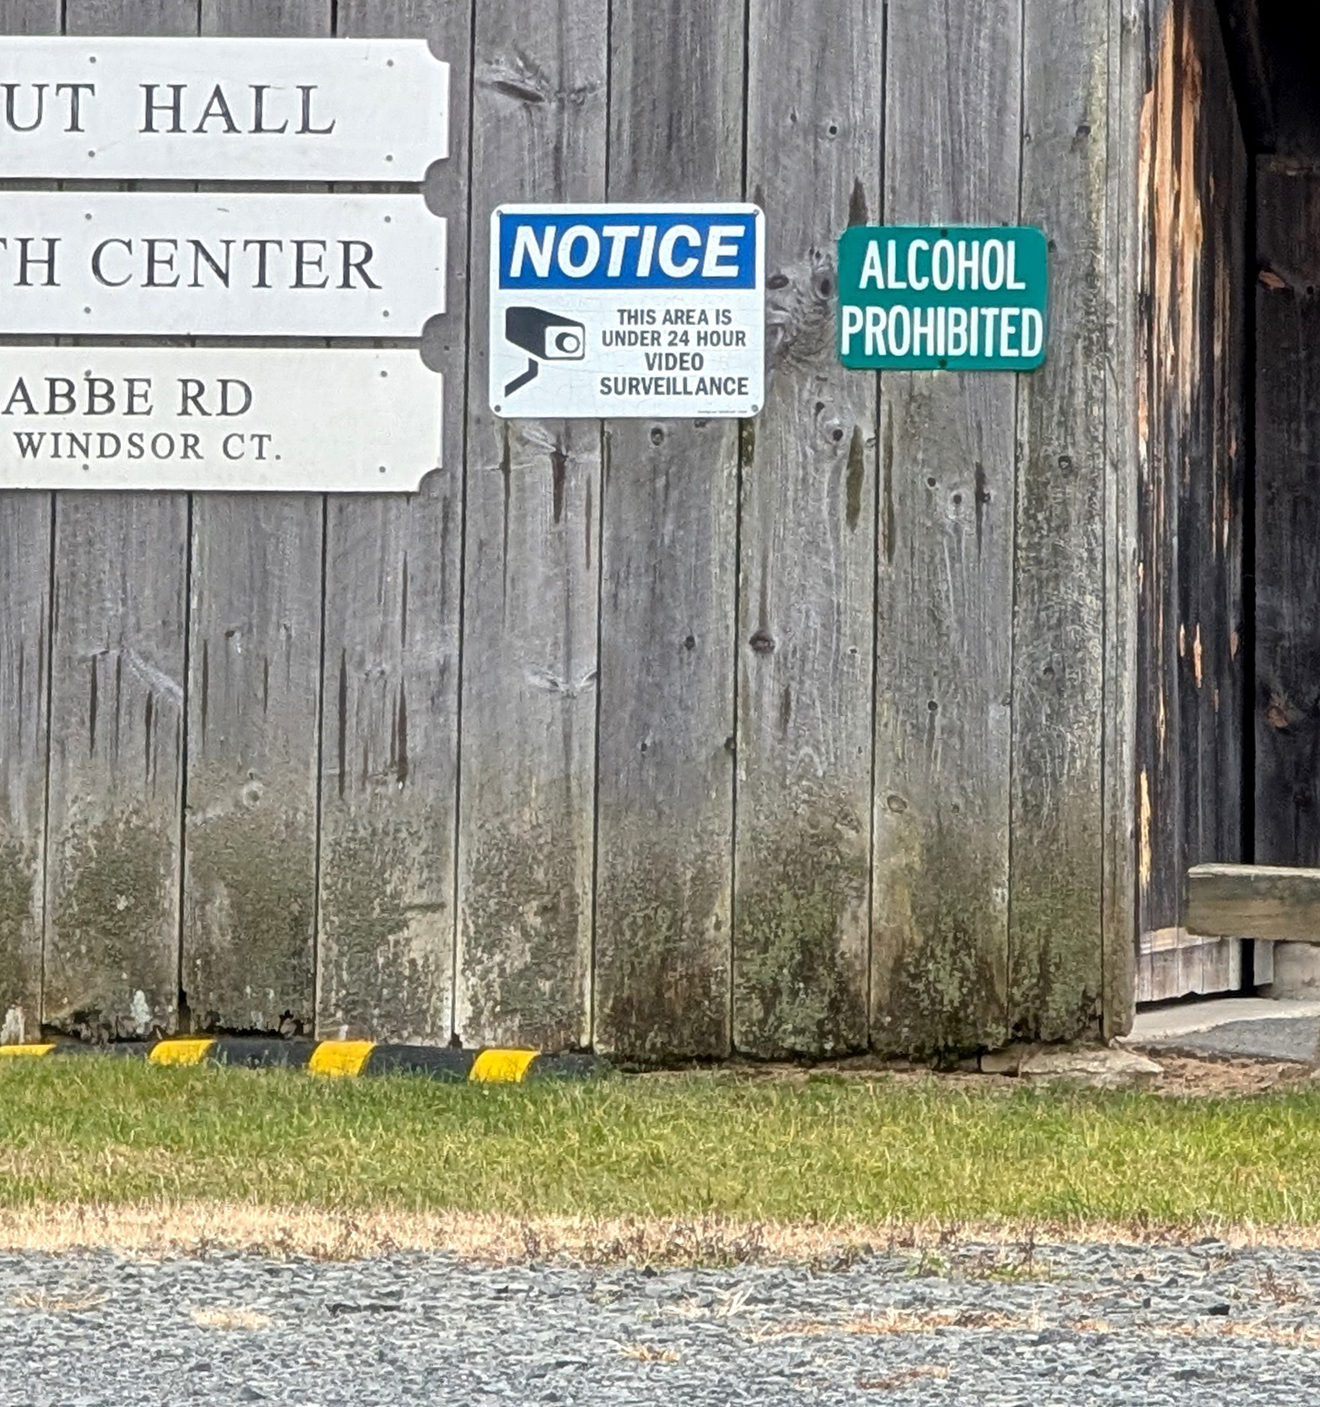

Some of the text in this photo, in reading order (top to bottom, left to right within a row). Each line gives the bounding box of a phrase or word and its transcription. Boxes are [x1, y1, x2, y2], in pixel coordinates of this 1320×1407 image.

[138, 84, 337, 135] HALL
[90, 238, 382, 290] CENTER
[509, 223, 746, 279] NOTICE
[859, 239, 1027, 291] ALCOHOL
[616, 308, 733, 326] THIS AREA IS
[840, 304, 1044, 358] PROHIBITED
[601, 330, 747, 348] UNDER 24 HOUR
[644, 352, 705, 371] VIDEO
[1, 376, 154, 417] ABBE
[176, 377, 253, 418] RD
[598, 376, 749, 396] SURVEILLANCE
[13, 431, 205, 460] WINDSOR
[222, 433, 282, 460] CT.
